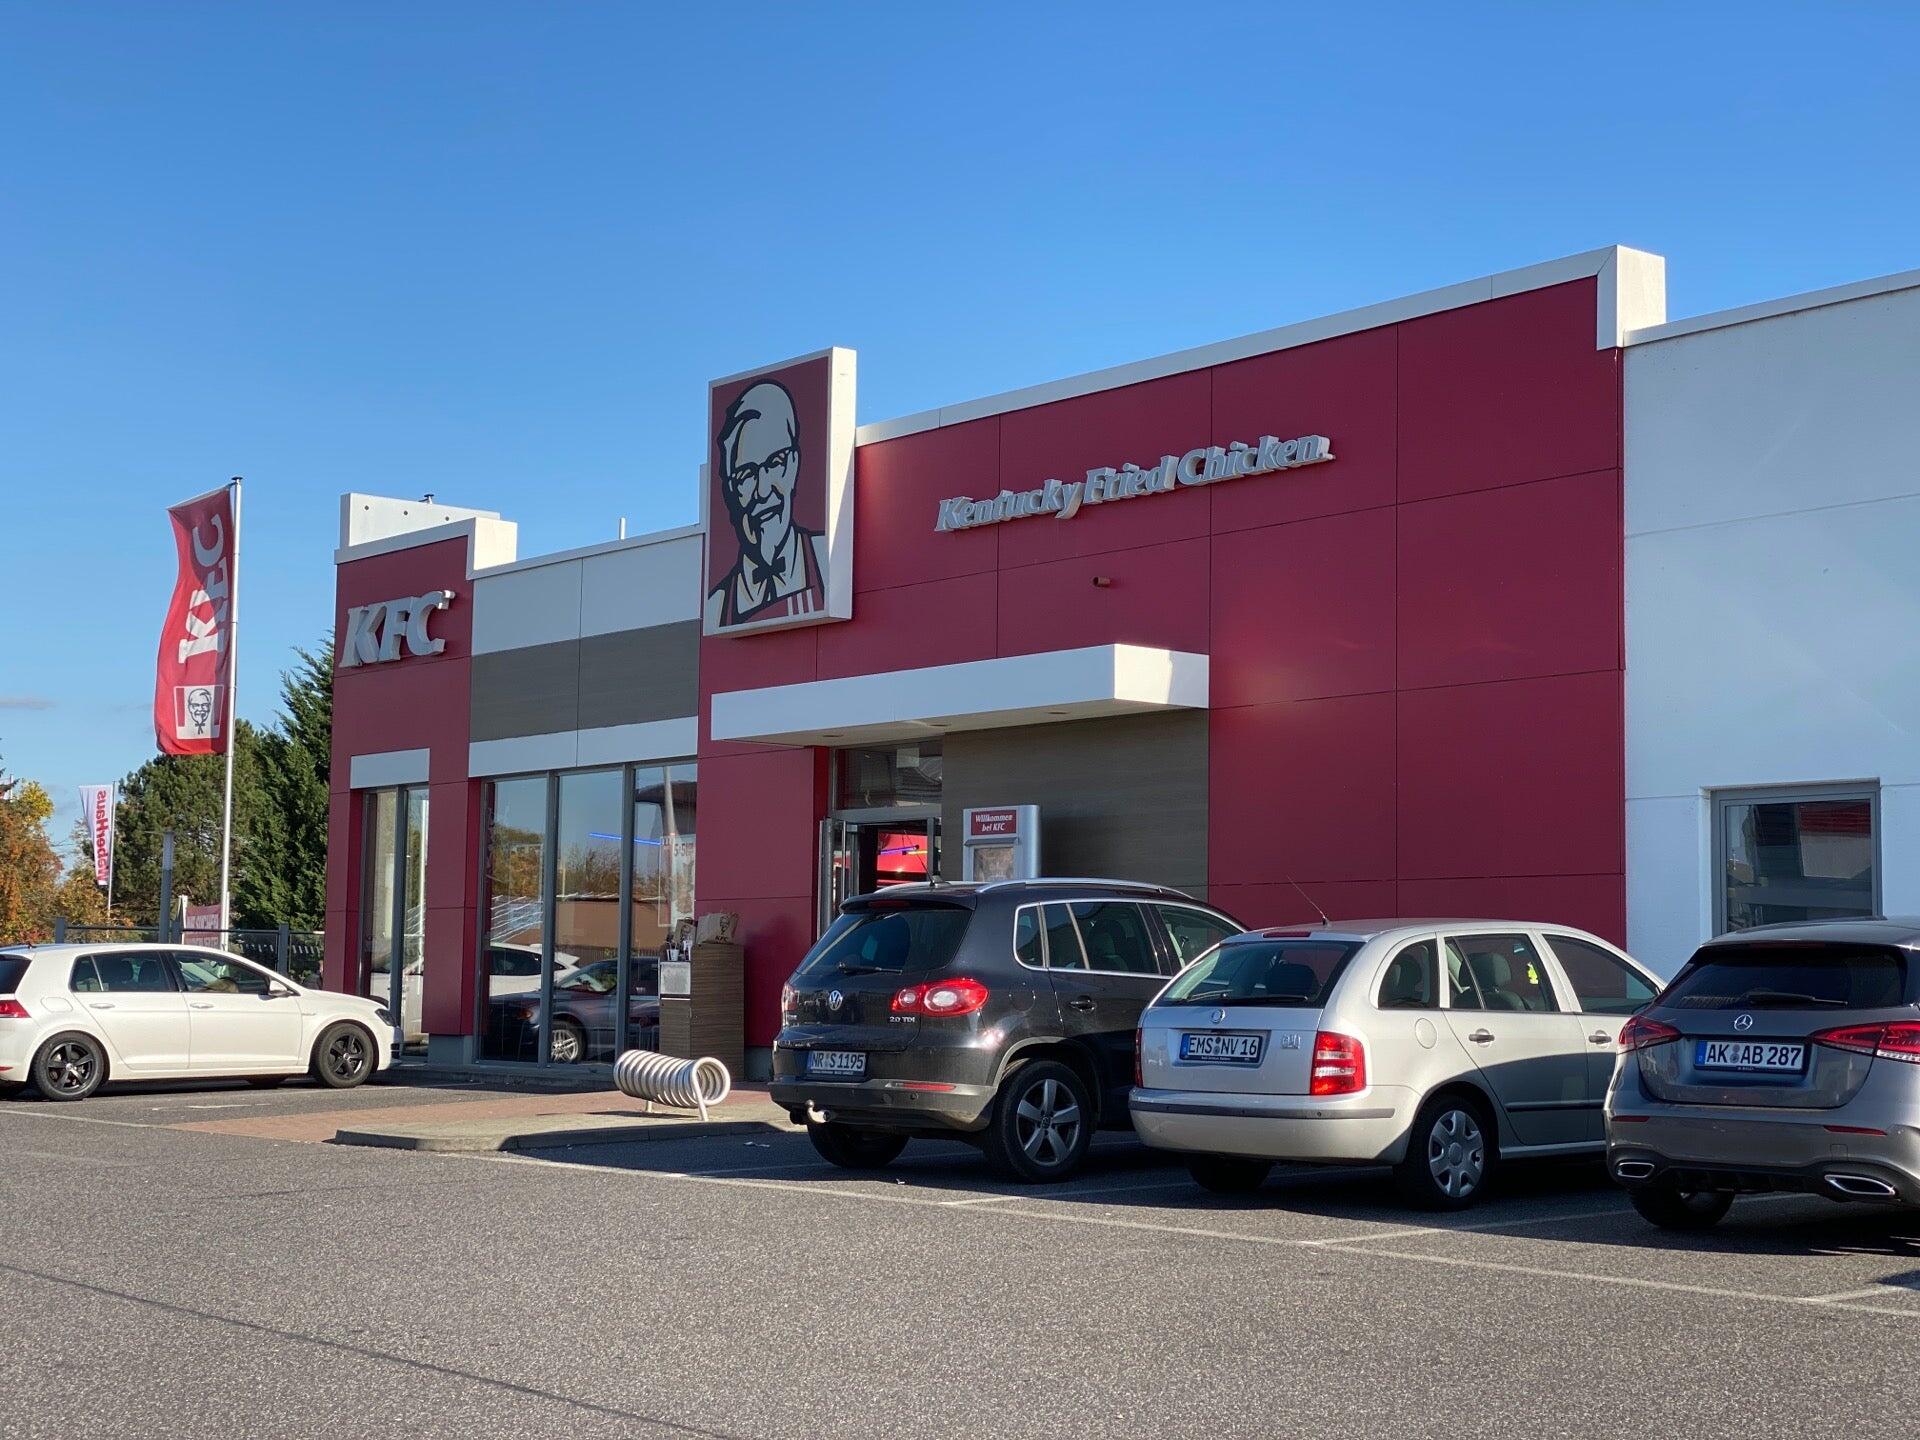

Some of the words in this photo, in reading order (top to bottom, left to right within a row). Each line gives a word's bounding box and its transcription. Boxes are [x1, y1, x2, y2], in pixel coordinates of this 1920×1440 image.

[935, 479, 1082, 532] Kentucky
[1082, 455, 1179, 505] Fried
[178, 513, 229, 664] KFC
[339, 590, 456, 668] KFC
[975, 814, 1013, 823] Willkommen
[993, 823, 1006, 831] KFC
[1188, 1036, 1213, 1054] EMS
[1221, 1037, 1239, 1055] NV
[1706, 1044, 1730, 1064] AK
[1741, 1045, 1763, 1064] AB
[1766, 1046, 1802, 1067] 287
